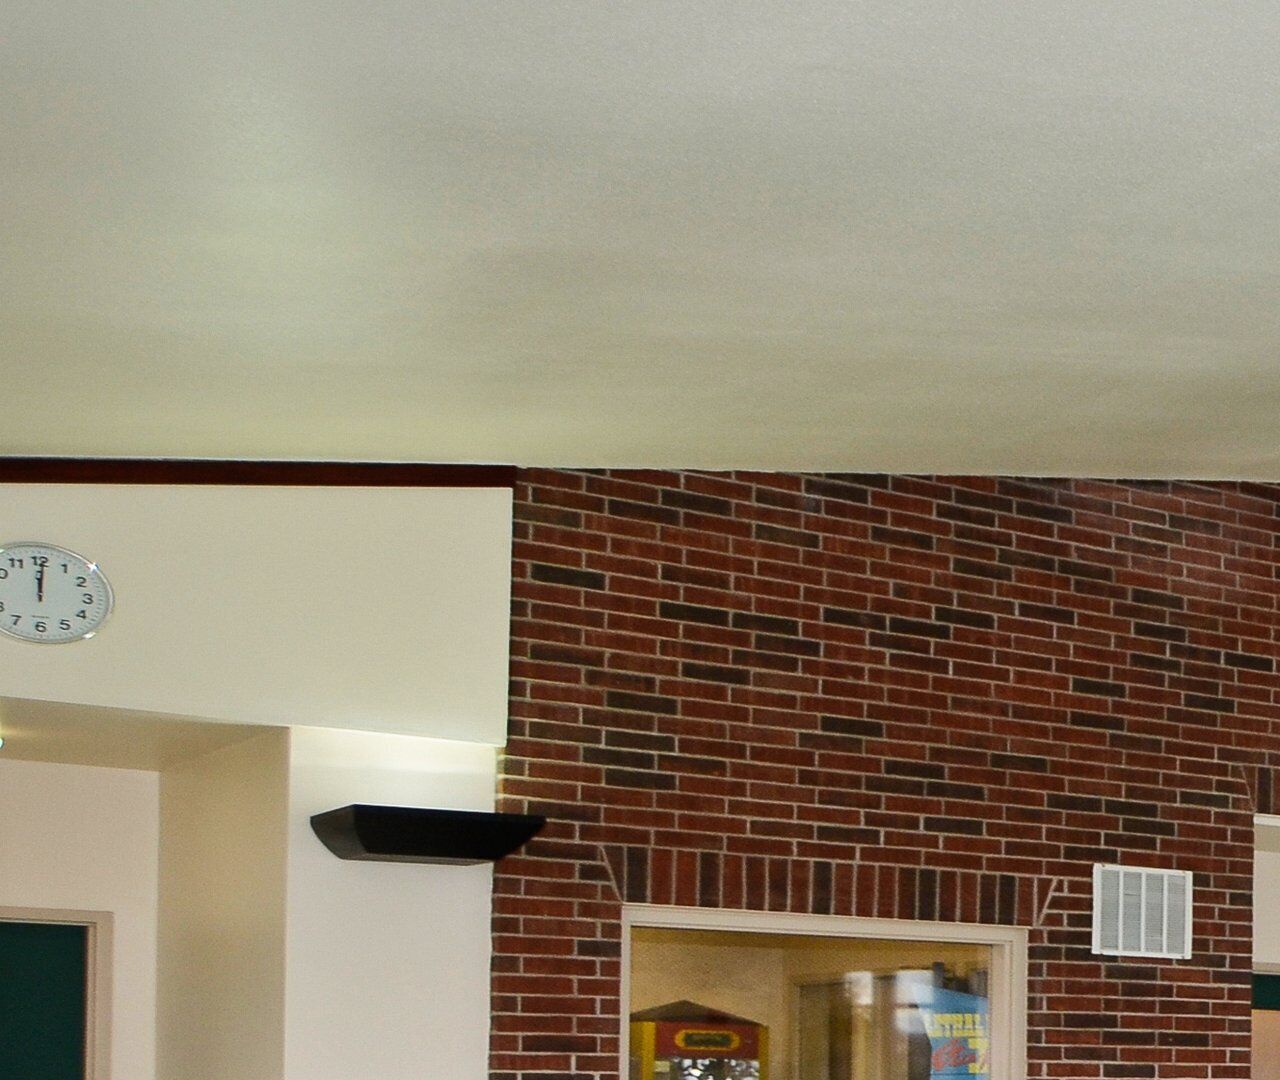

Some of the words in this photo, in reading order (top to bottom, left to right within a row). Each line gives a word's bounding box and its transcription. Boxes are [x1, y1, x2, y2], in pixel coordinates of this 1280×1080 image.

[8, 558, 24, 569] 11
[30, 556, 49, 568] 12
[0, 568, 9, 579] 0
[61, 563, 68, 573] 1
[76, 576, 87, 588] 2
[82, 593, 94, 605] 3
[10, 614, 22, 626] 7
[76, 609, 87, 620] 4
[35, 621, 47, 633] 6
[59, 619, 71, 630] 5
